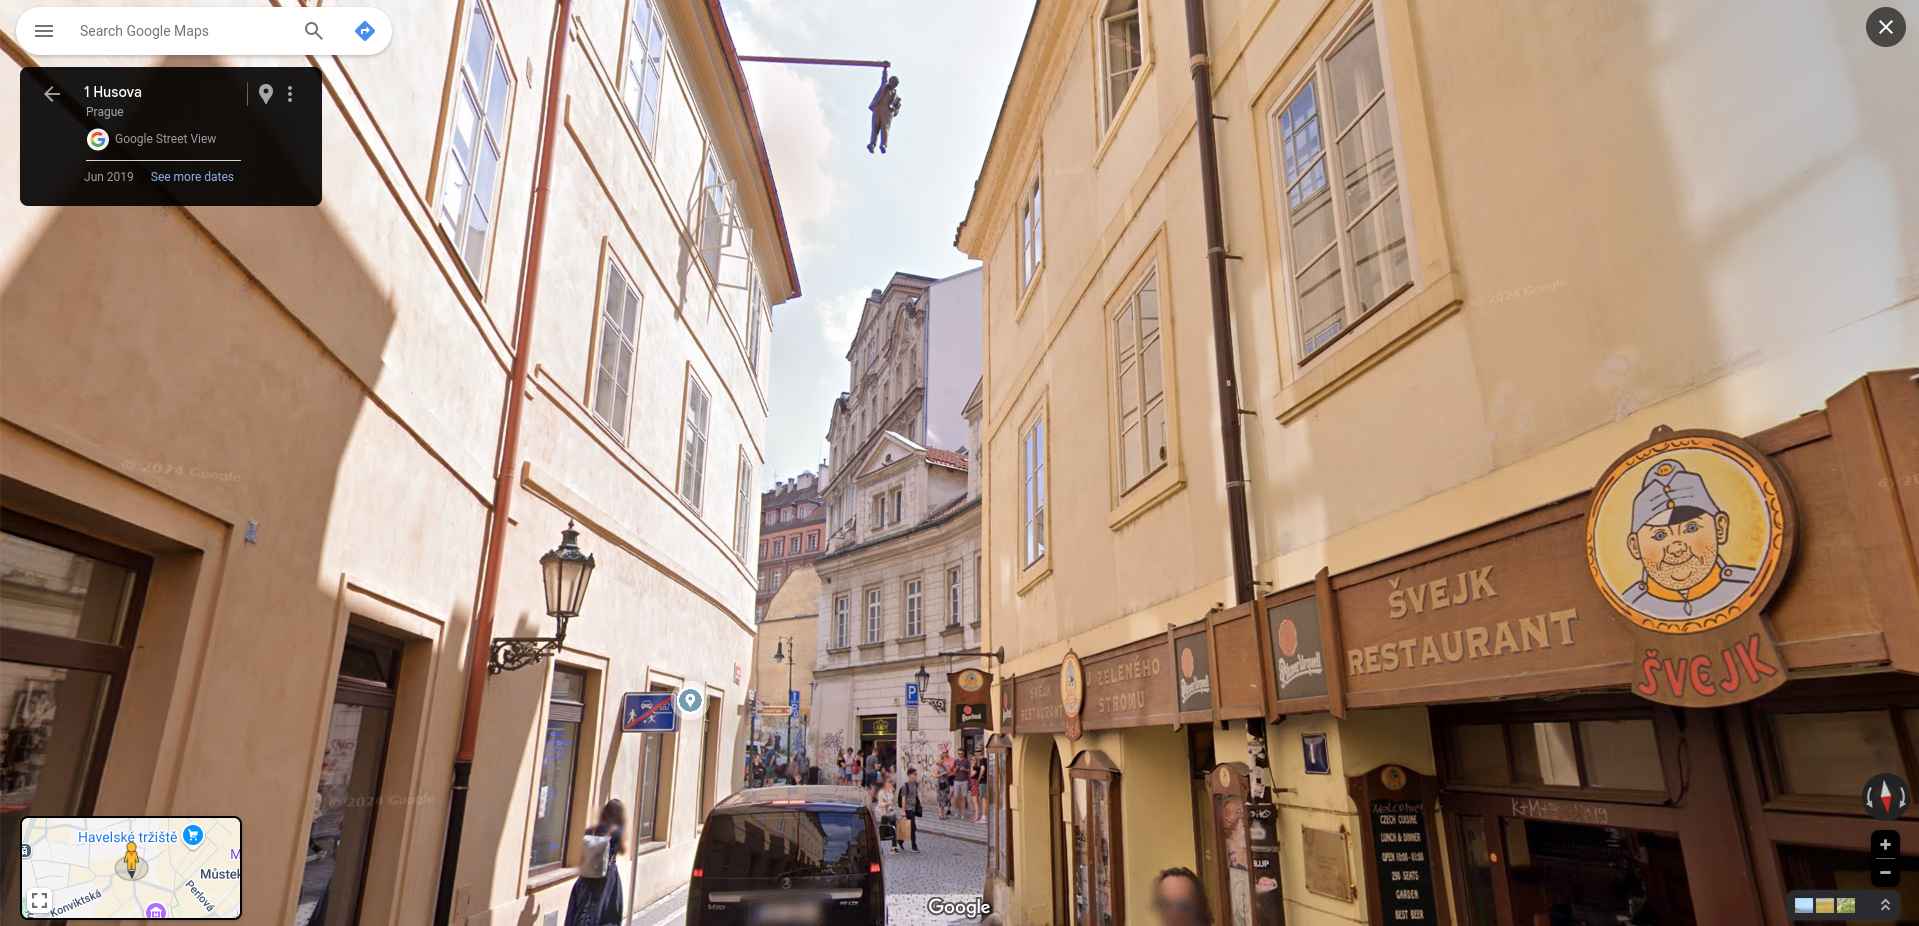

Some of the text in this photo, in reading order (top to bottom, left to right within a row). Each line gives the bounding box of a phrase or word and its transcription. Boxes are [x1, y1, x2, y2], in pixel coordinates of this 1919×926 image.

[1387, 565, 1500, 620] ŠVEJK
[1346, 608, 1581, 677] RESTAURANT
[1096, 655, 1161, 686] ZELENÉHO
[1637, 632, 1776, 698] ŠVEJK
[908, 686, 917, 699] P
[1097, 690, 1146, 713] STROMU
[1380, 832, 1397, 843] LUNCH
[1402, 870, 1420, 881] SEATS
[1395, 889, 1419, 900] GARDEN
[1395, 909, 1425, 920] BEST BEER
